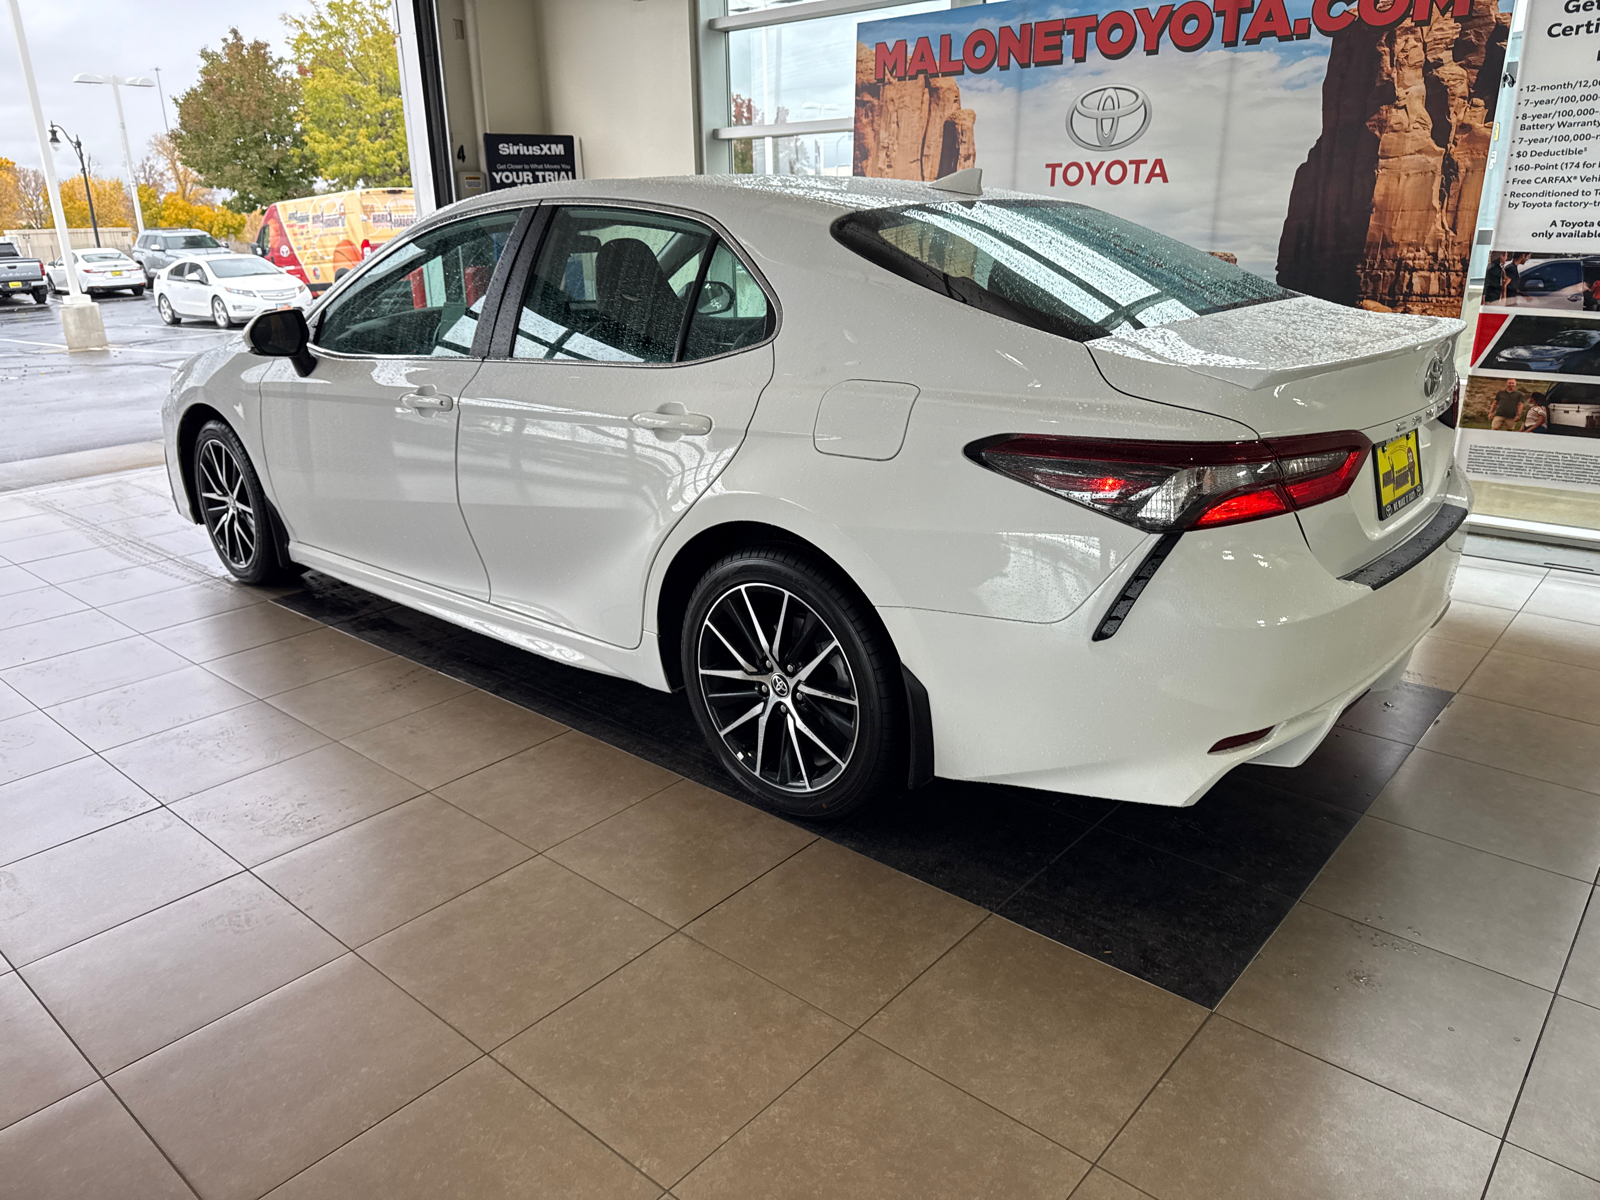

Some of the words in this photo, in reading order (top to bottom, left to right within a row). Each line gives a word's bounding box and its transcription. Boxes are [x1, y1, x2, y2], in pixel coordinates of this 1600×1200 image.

[1564, 0, 1600, 13] Get
[875, 0, 1473, 82] MALONETOYOTA.COM
[1520, 122, 1555, 131] Battery
[457, 144, 466, 163] 4
[498, 143, 565, 156] SiriusXM
[1516, 150, 1528, 159] $0
[1514, 163, 1559, 172] 160-Point
[1560, 161, 1581, 171] (174
[1582, 160, 1597, 169] for
[491, 171, 534, 184] YOUR
[1045, 158, 1169, 188] TOYOTA
[1512, 177, 1532, 185] Free
[1510, 189, 1580, 198] Reconditioned
[1581, 189, 1592, 197] to
[1508, 201, 1520, 210] by
[1522, 201, 1553, 210] Toyota
[1549, 220, 1558, 228] A
[1560, 219, 1595, 229] Toyota
[1531, 230, 1554, 239] only
